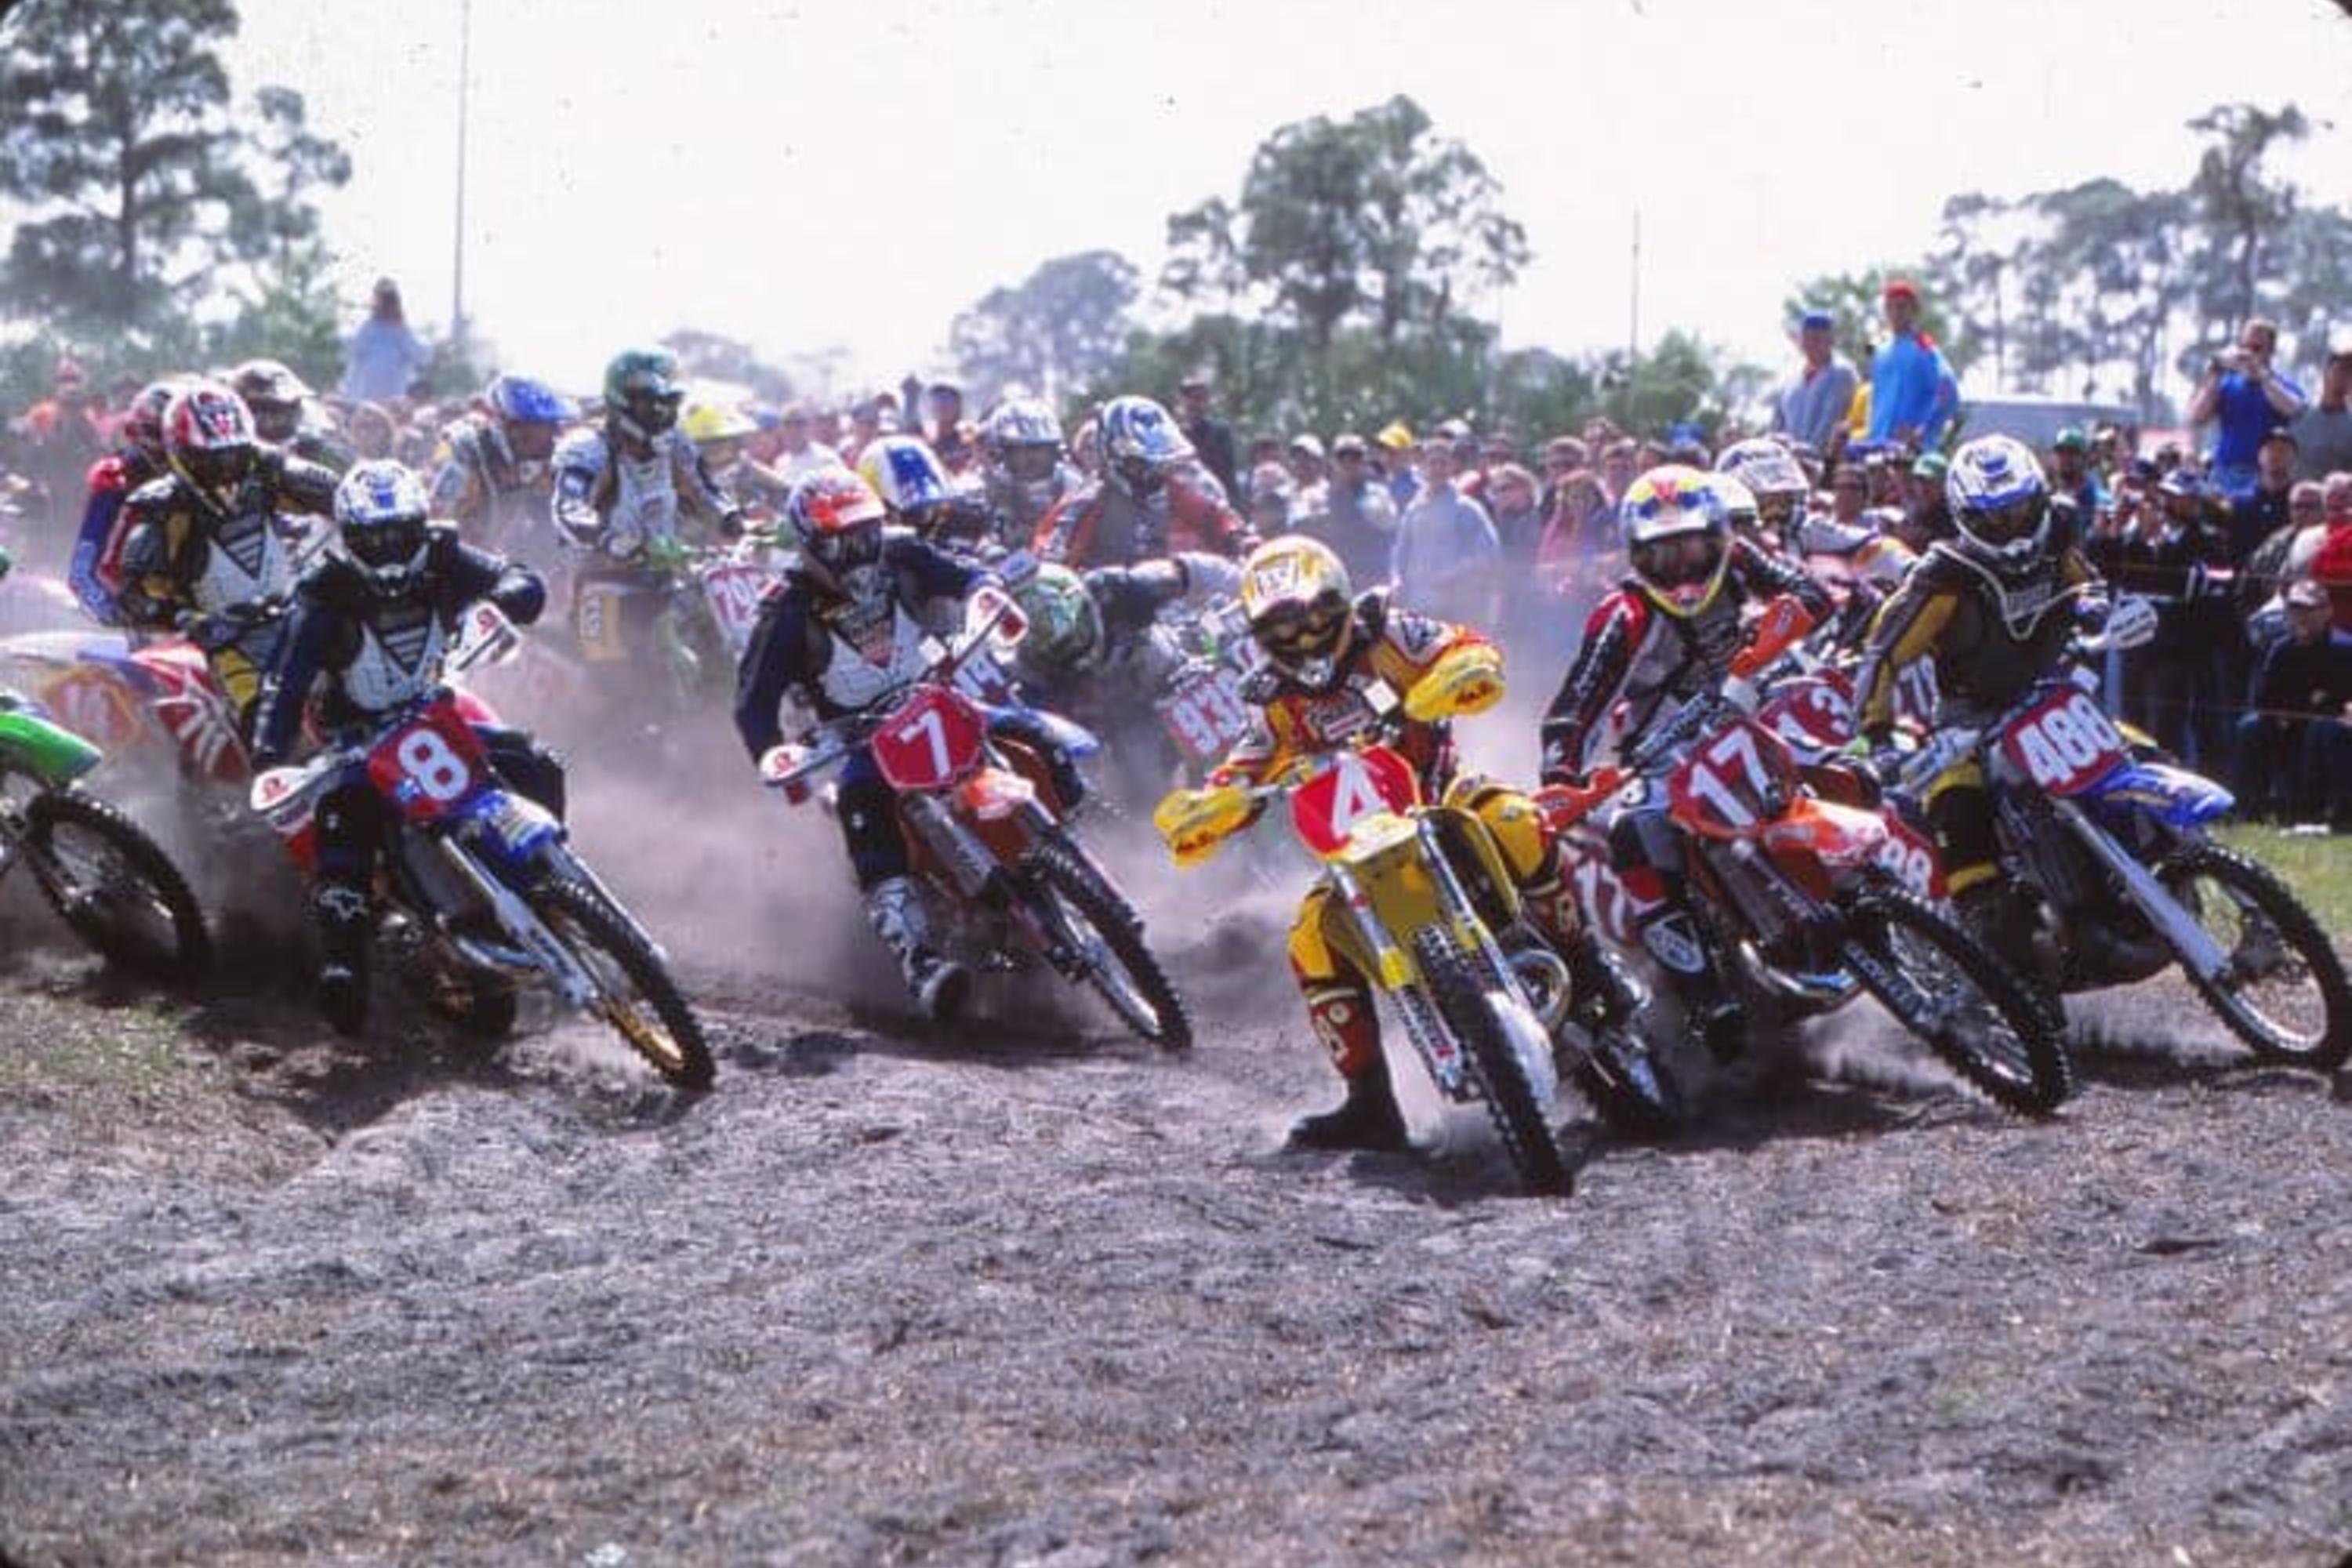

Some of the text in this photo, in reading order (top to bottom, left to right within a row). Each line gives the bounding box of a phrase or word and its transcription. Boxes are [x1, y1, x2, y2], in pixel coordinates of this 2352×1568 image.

[398, 729, 469, 800] 8
[898, 709, 952, 780] 7
[1687, 727, 1772, 826] 17
[1331, 750, 1392, 840] 4
